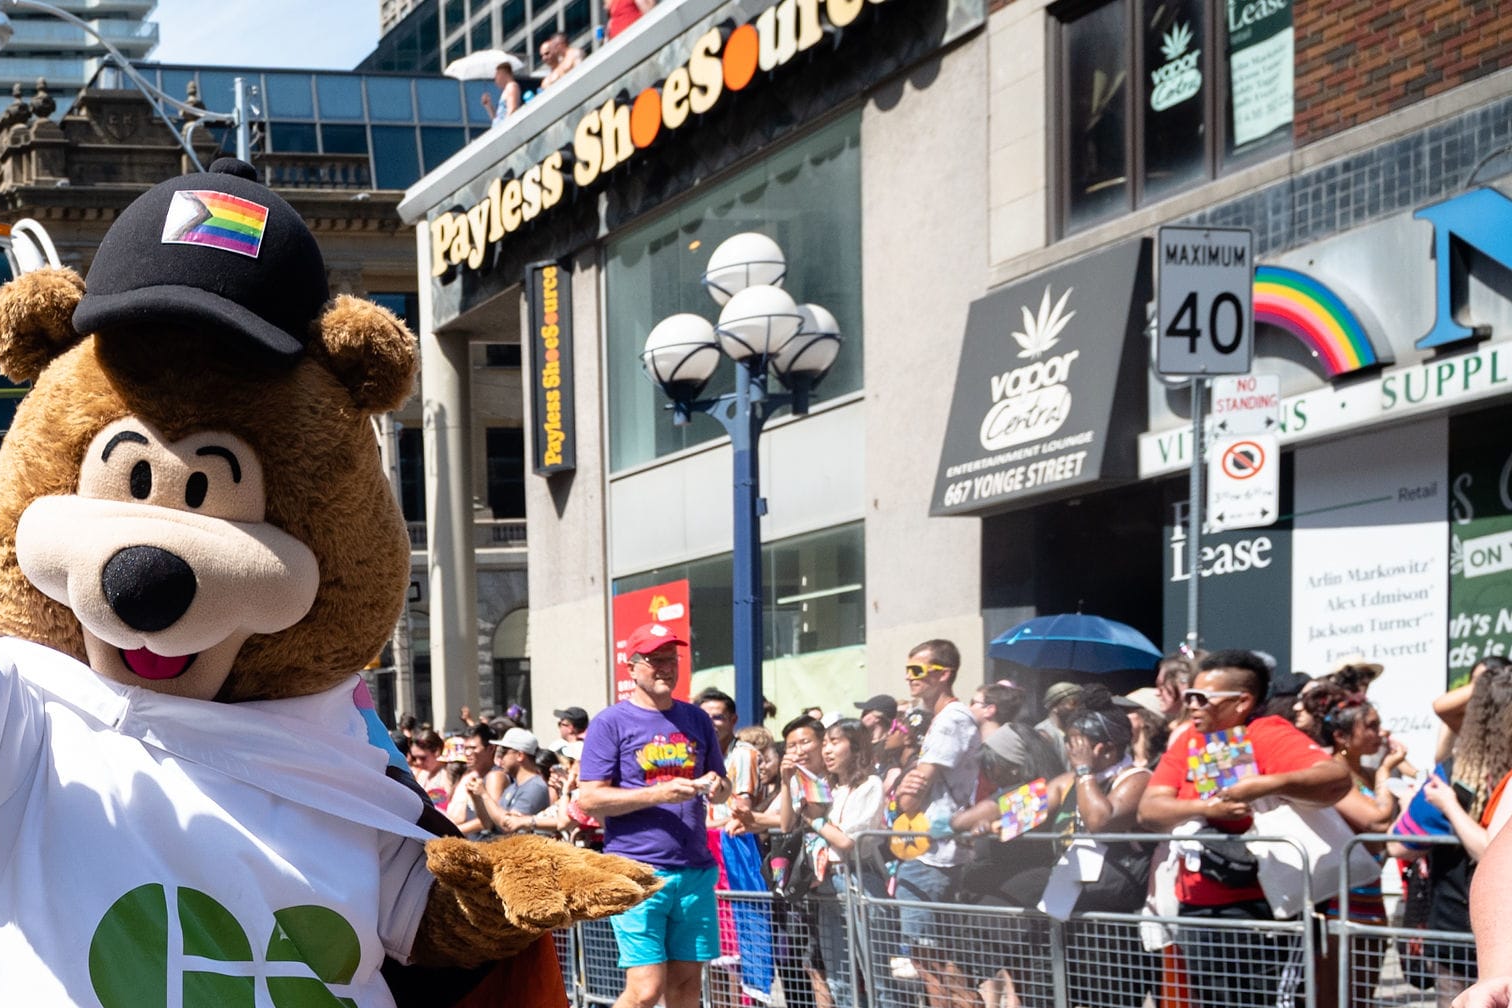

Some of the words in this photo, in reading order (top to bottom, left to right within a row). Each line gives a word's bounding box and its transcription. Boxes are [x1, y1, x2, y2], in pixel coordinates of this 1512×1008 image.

[430, 149, 565, 278] Payless
[572, 0, 887, 188] ShoeSour
[1165, 243, 1246, 268] MAXIMUM
[541, 265, 561, 389] ShoeSource
[1165, 291, 1244, 355] 40
[990, 349, 1080, 403] vapor
[1236, 377, 1257, 392] NO
[1381, 351, 1509, 412] SUPPL
[543, 389, 566, 467] Payless
[986, 388, 1071, 441] Central
[1216, 394, 1278, 413] STANDING
[944, 480, 972, 507] 667
[973, 465, 1026, 500] YONGE
[1025, 450, 1087, 488] STREET
[945, 446, 1041, 479] ENTERTAINMENT
[1041, 430, 1095, 455] LOUNGE
[1397, 481, 1439, 502] Retail
[1170, 535, 1273, 582] Lease
[1469, 545, 1502, 568] ON
[643, 741, 689, 761] RIDE
